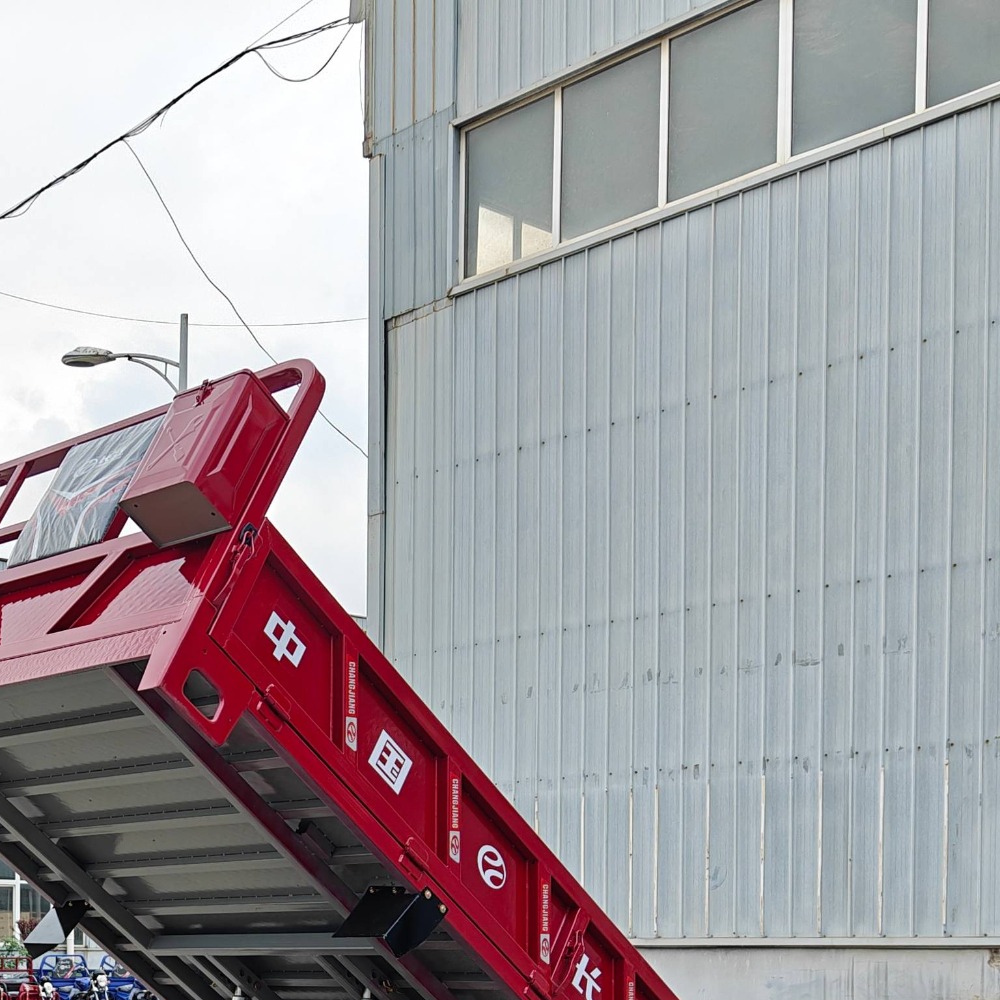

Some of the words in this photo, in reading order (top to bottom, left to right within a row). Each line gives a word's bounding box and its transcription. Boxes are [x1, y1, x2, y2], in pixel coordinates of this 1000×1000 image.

[264, 610, 413, 795] 中国
[348, 661, 356, 715] CHANGJIANG
[451, 778, 459, 829] CHANGJIANG
